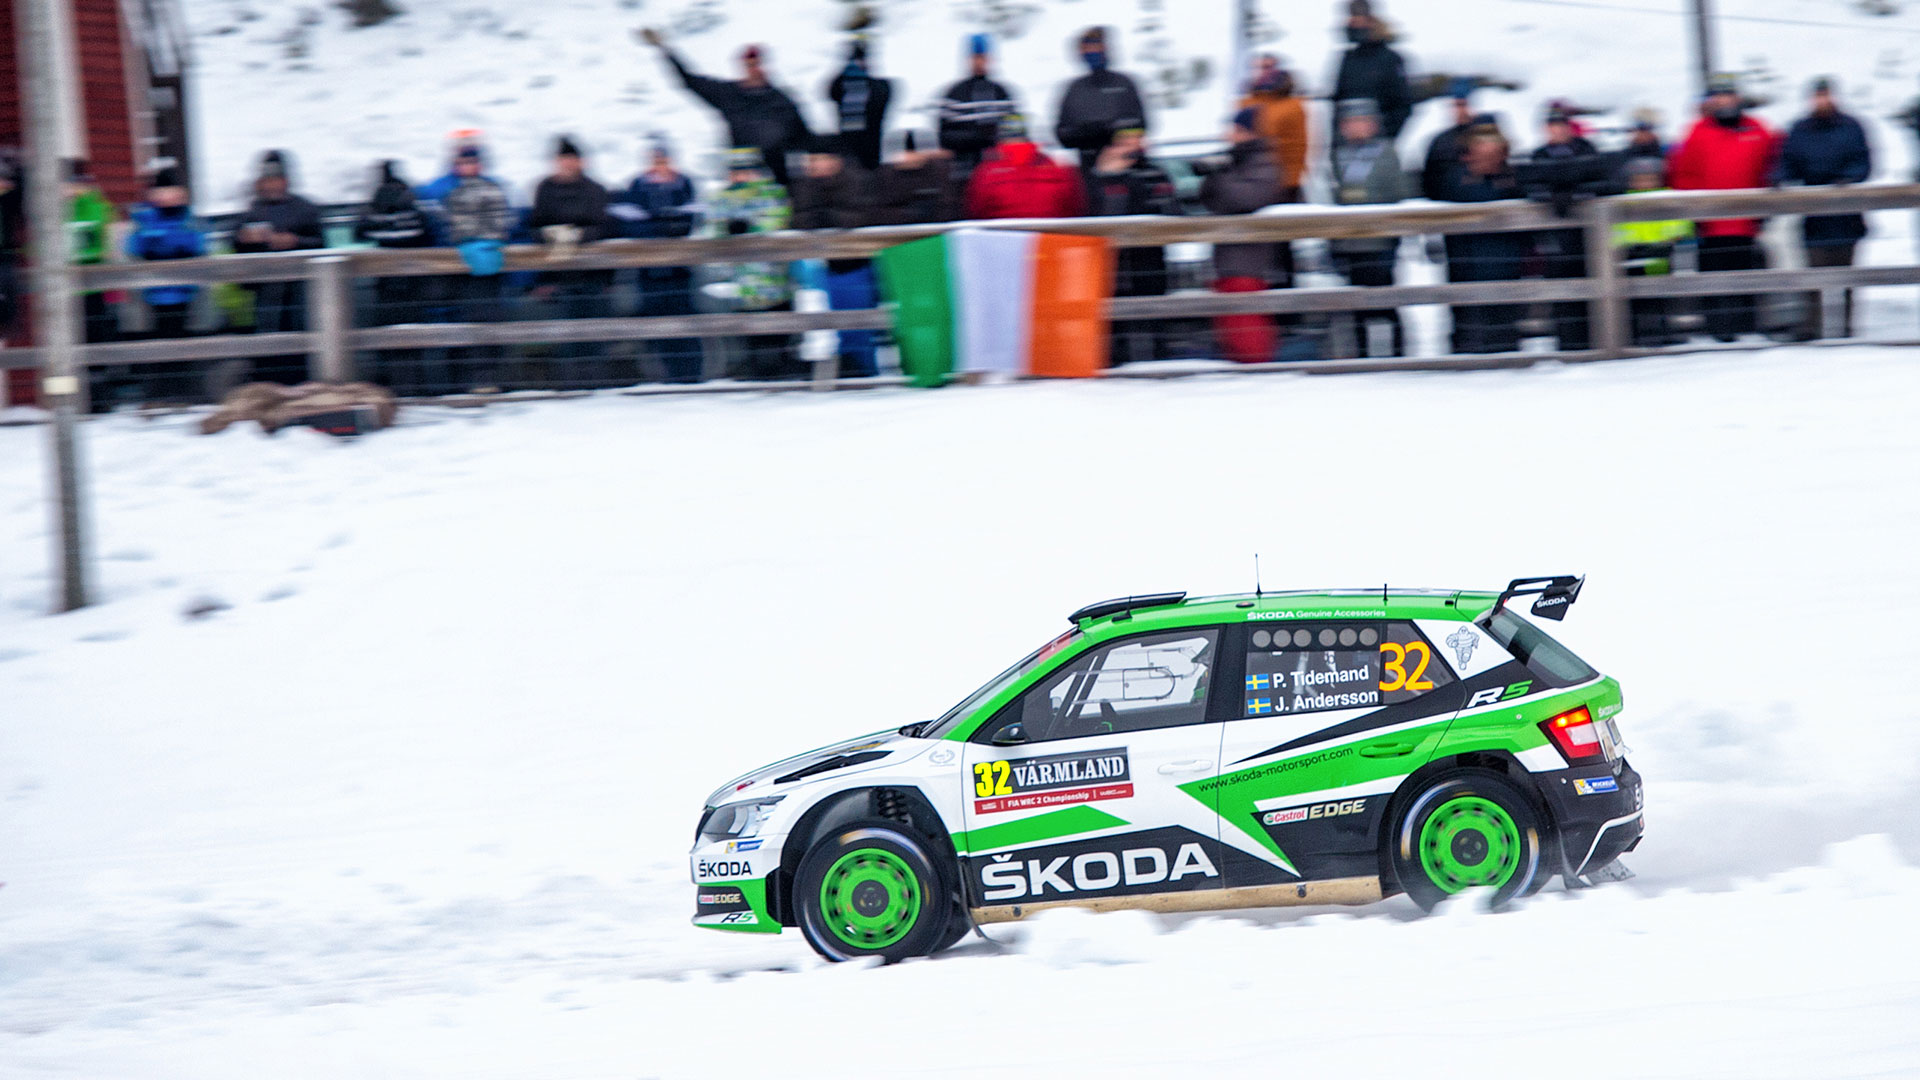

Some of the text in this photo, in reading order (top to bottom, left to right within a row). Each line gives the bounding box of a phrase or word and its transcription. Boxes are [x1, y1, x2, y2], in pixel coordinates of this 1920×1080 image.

[1536, 596, 1567, 608] ŠKODA
[1247, 609, 1386, 620] ŠKODA Genuine Accessories
[1272, 664, 1369, 688] P. Tidemand
[1378, 641, 1433, 692] 32
[1275, 690, 1379, 712] J. Andersson
[1466, 680, 1533, 708] R5
[974, 760, 1013, 798] 32
[1013, 756, 1125, 787] VÄRMLAND
[1198, 746, 1354, 793] www.skoda-motorsport.com
[1007, 799, 1020, 808] FIA
[1020, 797, 1036, 806] WRC
[1036, 796, 1042, 804] 2
[1042, 792, 1090, 803] Championship
[1309, 799, 1367, 819] EDGE
[1274, 810, 1306, 823] Castrol
[699, 859, 752, 878] ŠKODA
[981, 842, 1219, 901] ŠKODA
[714, 893, 742, 904] EDGE
[721, 912, 755, 924] R5
